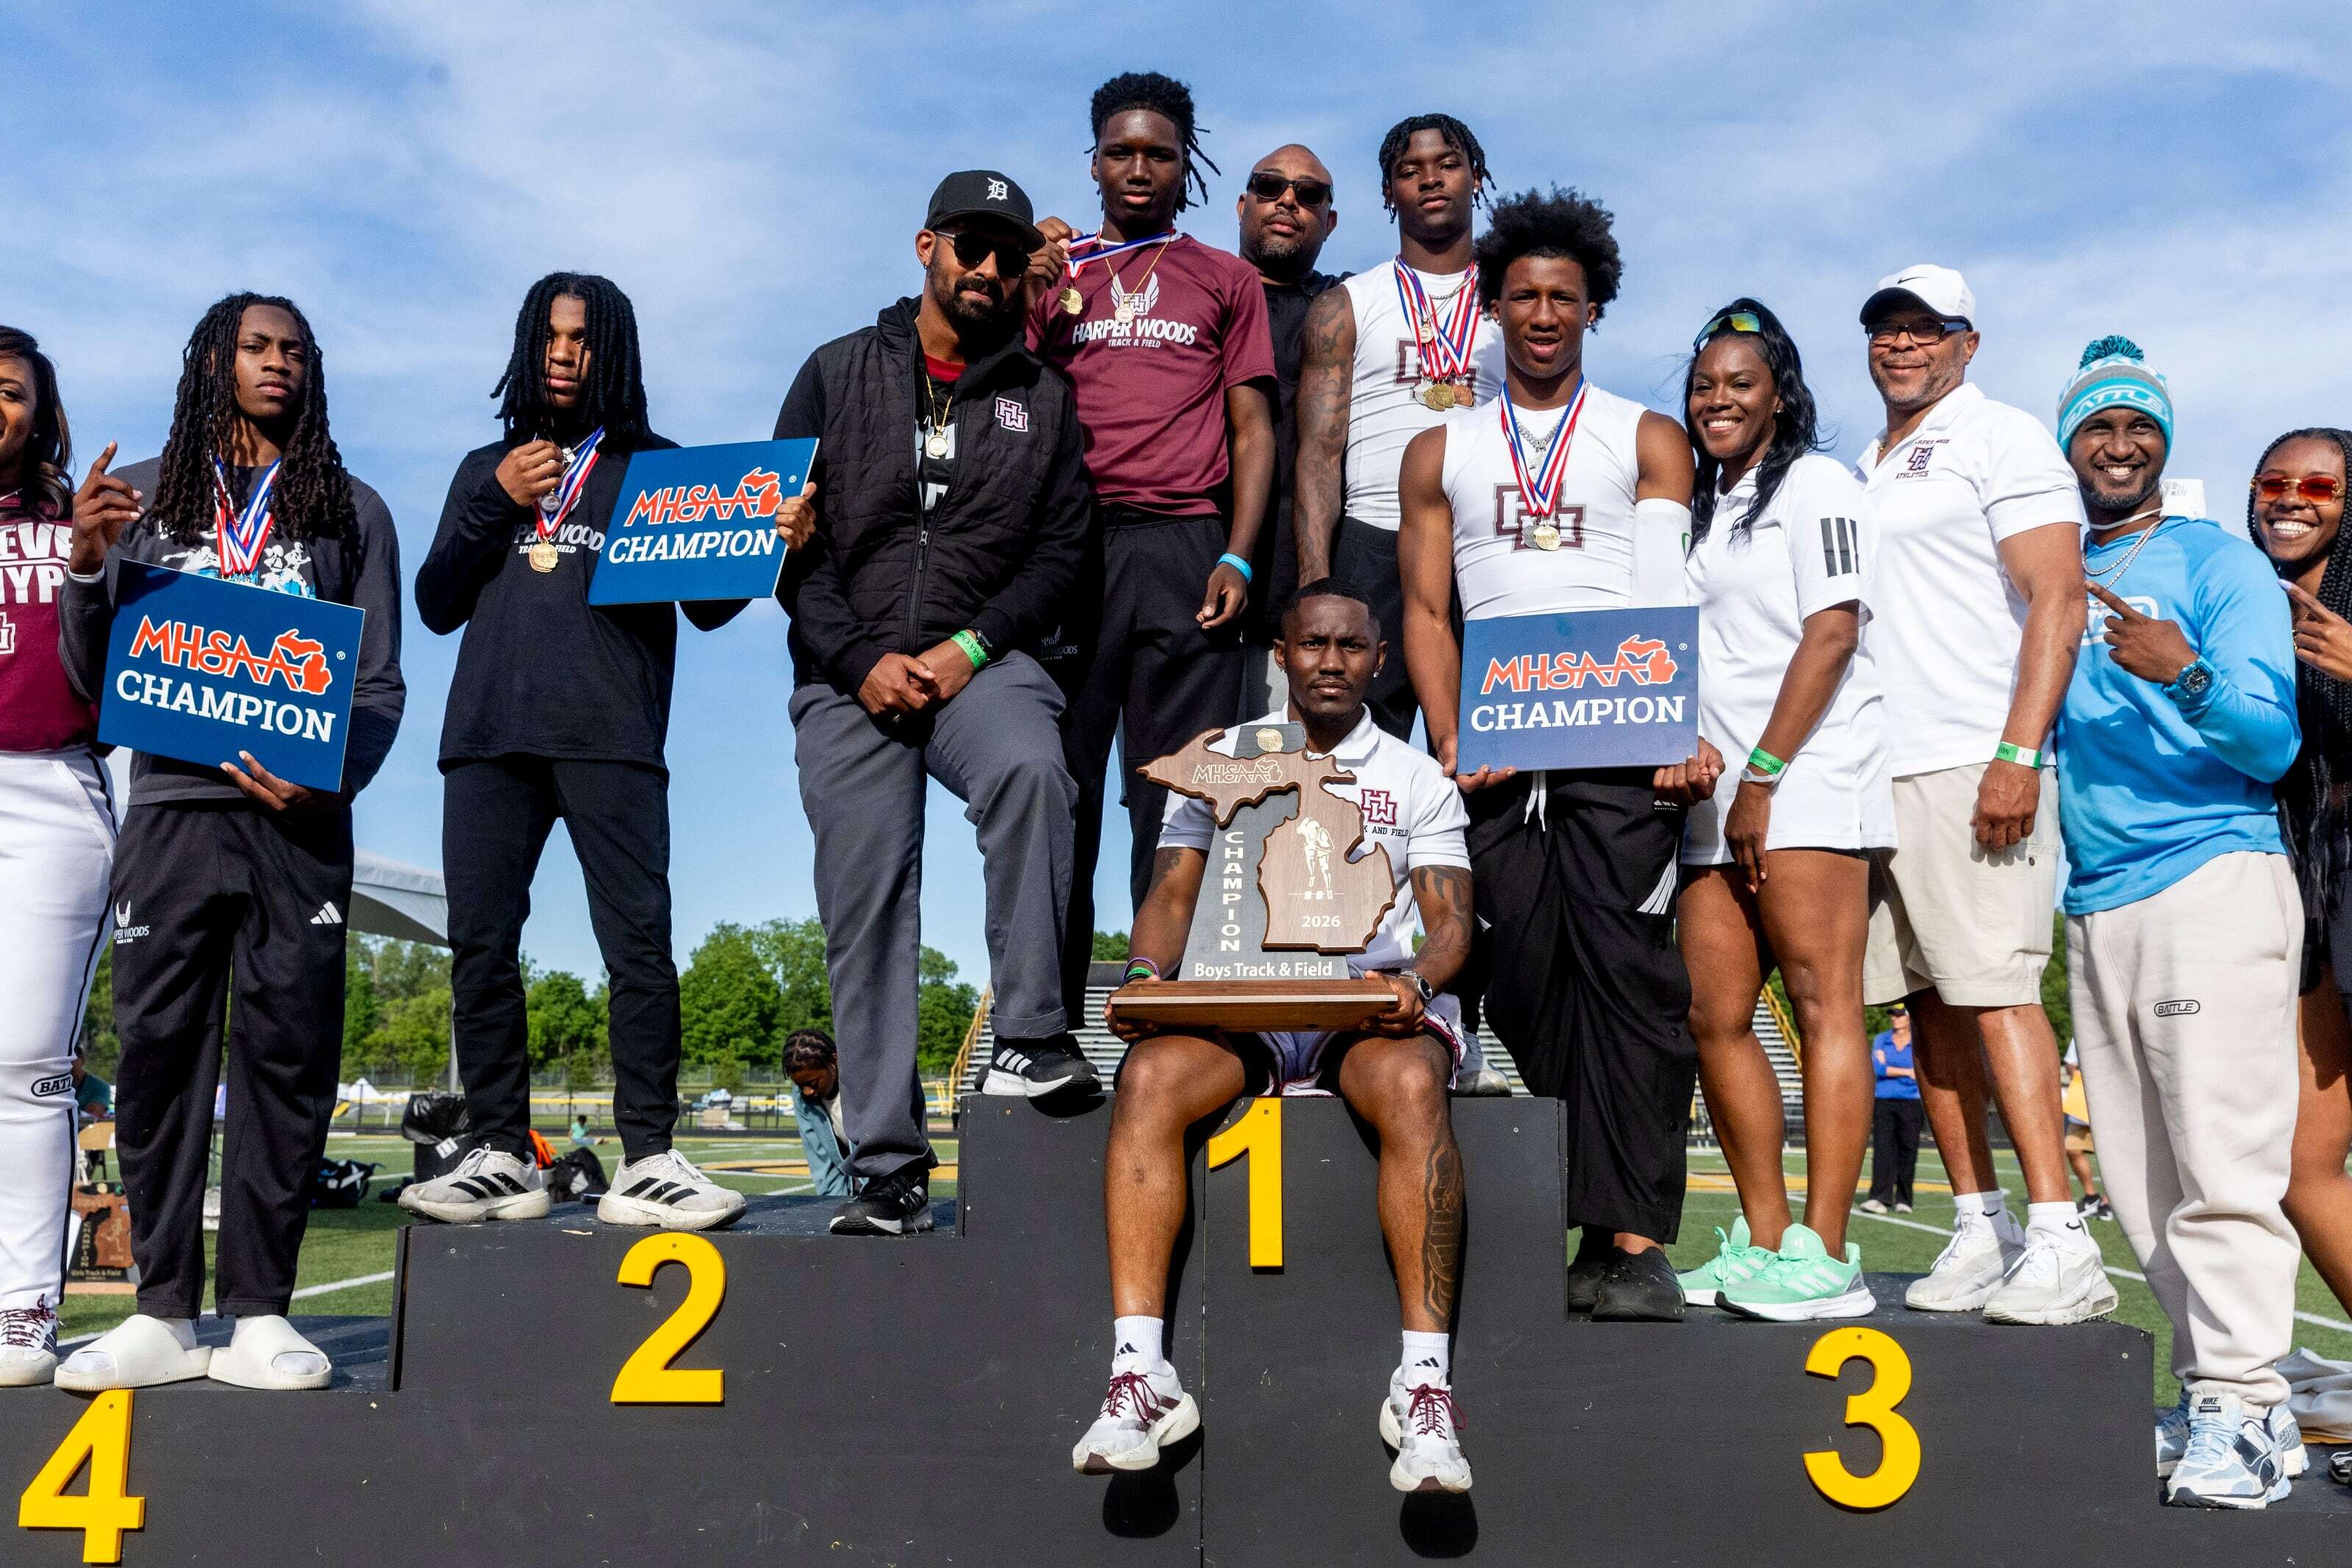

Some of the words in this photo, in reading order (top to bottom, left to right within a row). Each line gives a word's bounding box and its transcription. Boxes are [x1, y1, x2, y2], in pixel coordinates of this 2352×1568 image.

[986, 177, 1008, 201] D
[1072, 318, 1132, 345] HARPER
[1136, 319, 1197, 345] WOODS
[1108, 339, 1131, 348] TRACK
[1133, 339, 1139, 347] &
[1141, 339, 1161, 348] FIELD
[995, 398, 1028, 432] HW
[1908, 447, 1934, 471] HW
[623, 479, 758, 527] MHSAA
[551, 524, 606, 553] WOOD
[609, 529, 778, 564] CHAMPION
[129, 615, 302, 692] MHSAA
[1480, 650, 1649, 694] MHSAA
[116, 669, 336, 743] CHAMPION
[1471, 696, 1686, 732] CHAMPION
[1191, 764, 1269, 783] MHSAA
[1360, 788, 1397, 825] HW
[1372, 826, 1388, 835] AND
[1391, 828, 1409, 837] FIELD
[1220, 831, 1244, 952] CHAMPION
[124, 925, 150, 938] WOODS
[1302, 916, 1341, 927] 2026
[1194, 962, 1231, 981] Boys
[1234, 962, 1275, 977] Track
[1279, 962, 1291, 977] &
[1294, 961, 1333, 977] Field
[2158, 1003, 2194, 1014] BATTLE
[1208, 1097, 1283, 1267] 1
[610, 1231, 726, 1403] 2
[1803, 1326, 1921, 1508] 3
[2201, 1397, 2220, 1405] NIKE
[18, 1389, 145, 1563] 4
